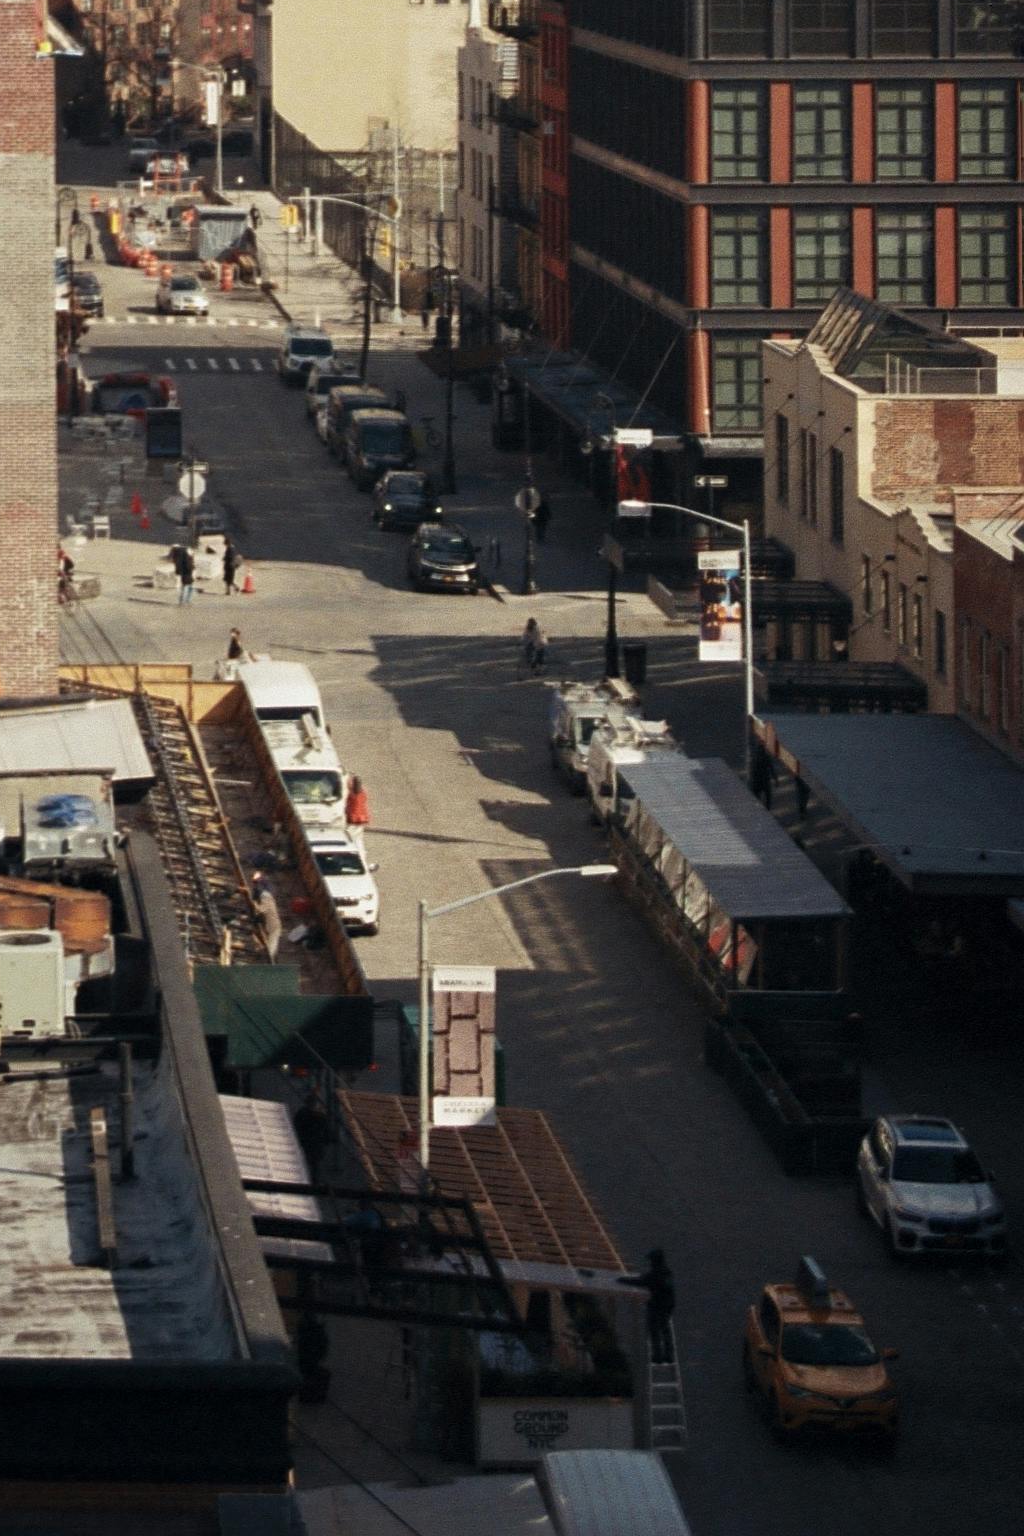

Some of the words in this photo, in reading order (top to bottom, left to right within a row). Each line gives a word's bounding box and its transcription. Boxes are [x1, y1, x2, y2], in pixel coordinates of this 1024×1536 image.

[513, 1410, 568, 1421] COMMON
[514, 1422, 569, 1433] GROUND
[529, 1438, 554, 1449] NYC
